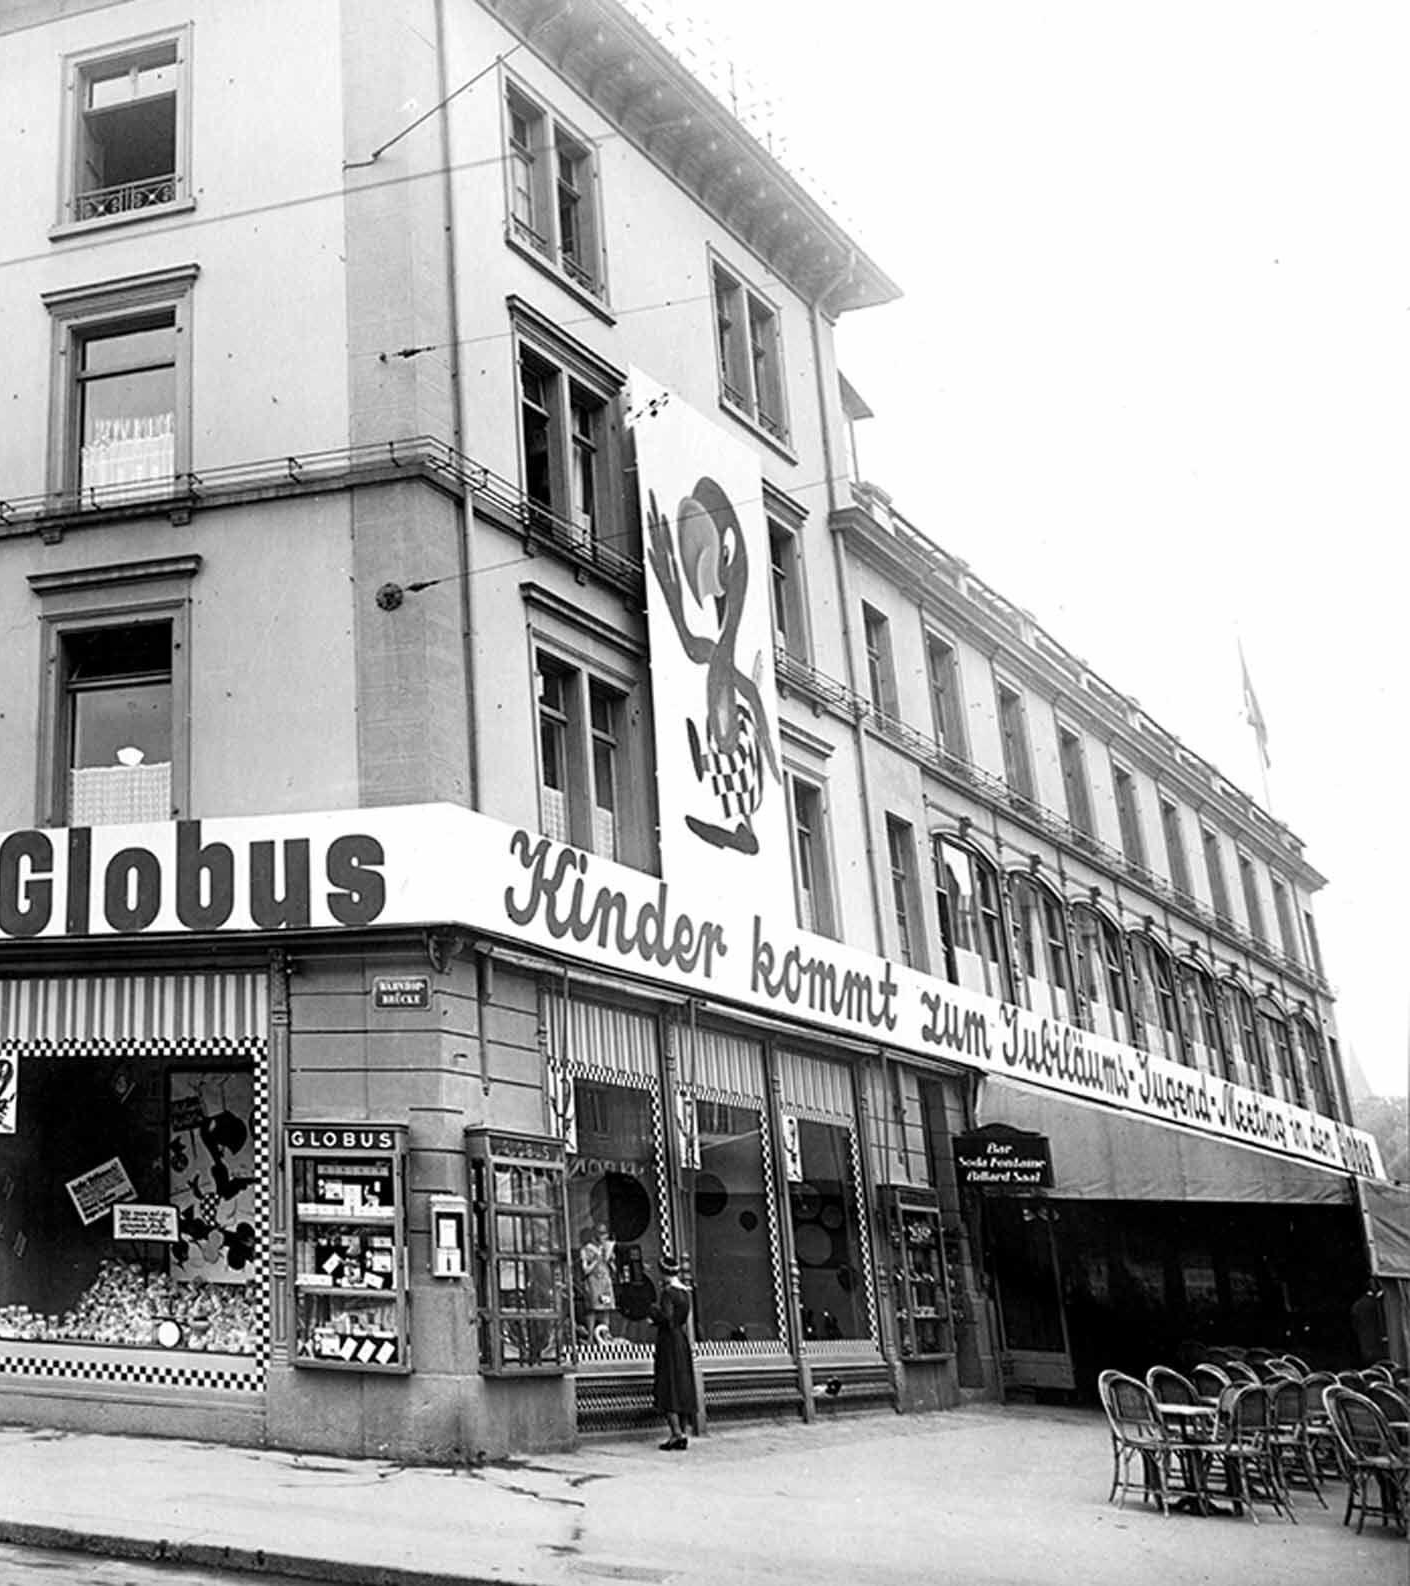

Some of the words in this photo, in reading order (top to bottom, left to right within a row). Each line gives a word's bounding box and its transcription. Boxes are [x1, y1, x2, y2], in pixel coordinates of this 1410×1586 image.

[503, 829, 728, 979] Kinder
[750, 915, 899, 1032] kommt
[920, 990, 993, 1060] zum
[290, 1130, 392, 1148] GLOBUS
[986, 1142, 1013, 1155] Bar
[958, 1156, 987, 1168] Soda
